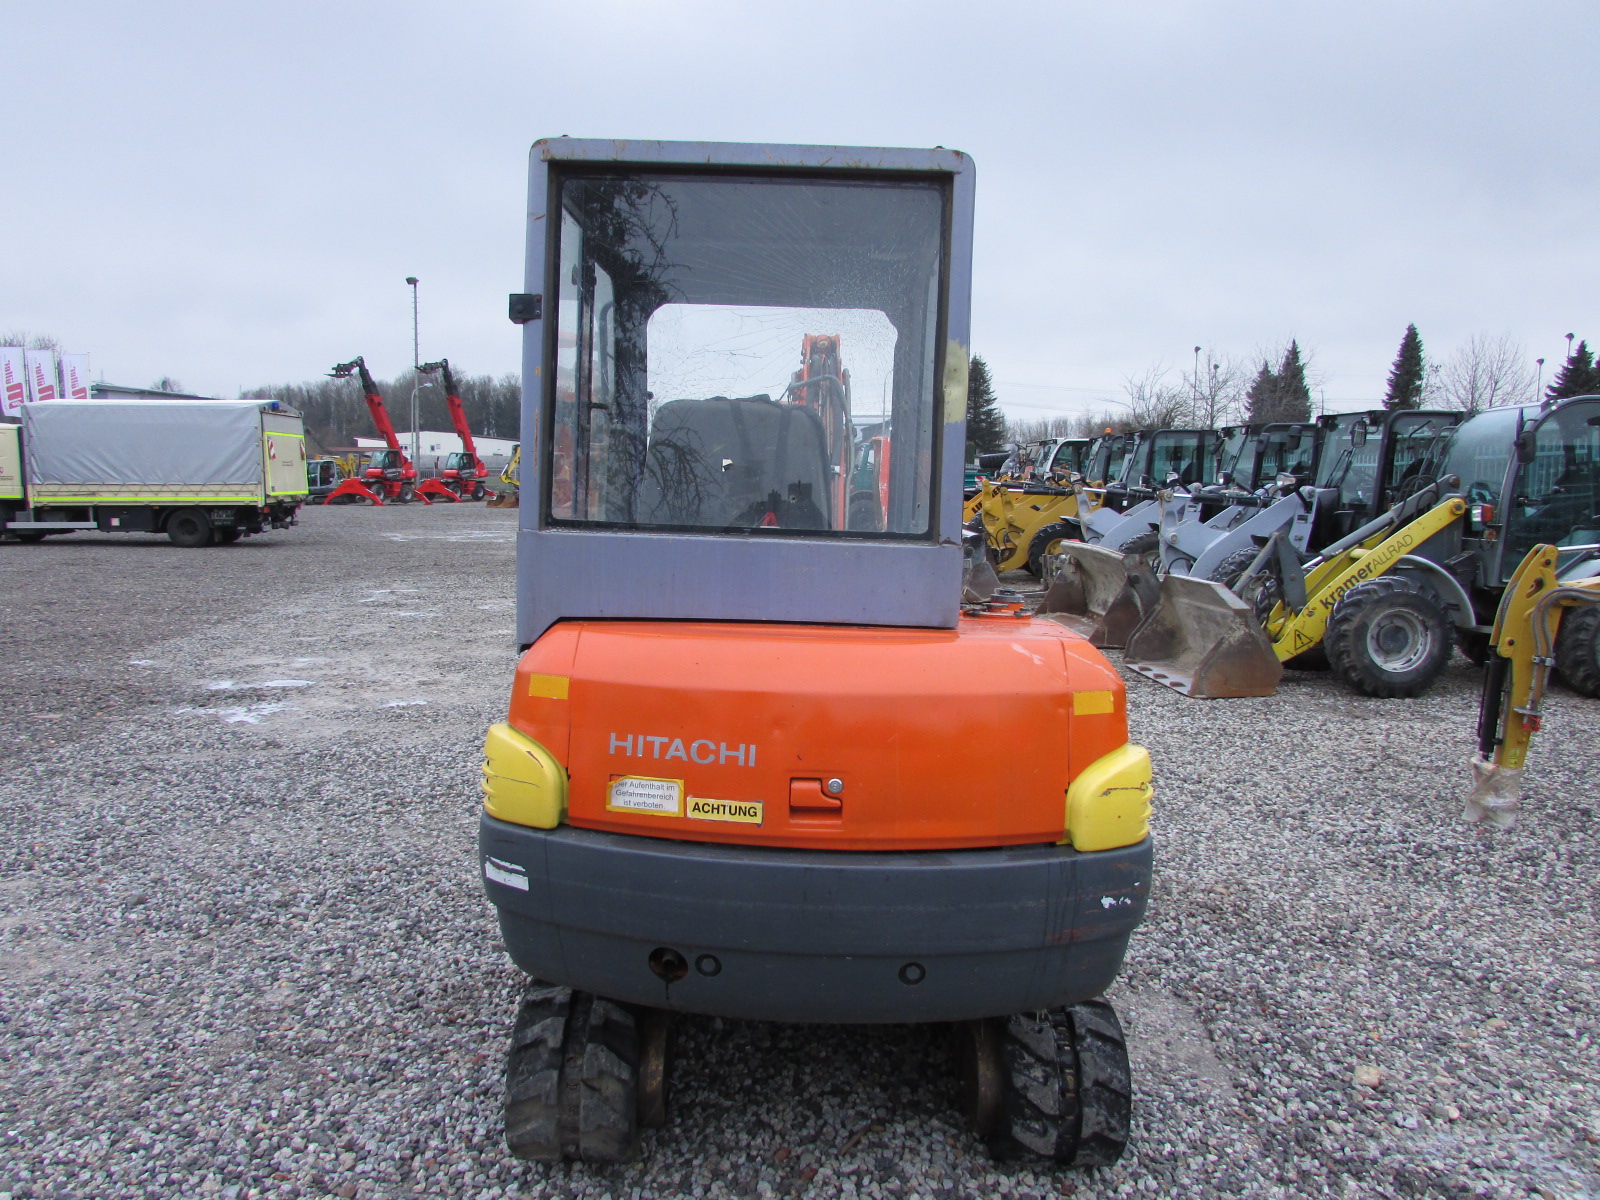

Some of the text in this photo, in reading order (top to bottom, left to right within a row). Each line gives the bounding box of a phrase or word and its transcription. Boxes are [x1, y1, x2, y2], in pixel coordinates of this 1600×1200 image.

[609, 732, 757, 767] HITACHI
[629, 781, 666, 792] Aufenthalt
[666, 784, 675, 792] im
[615, 789, 674, 801] Gefahrenbereich
[633, 799, 666, 810] verboten.
[692, 802, 758, 818] ACHTUNG
